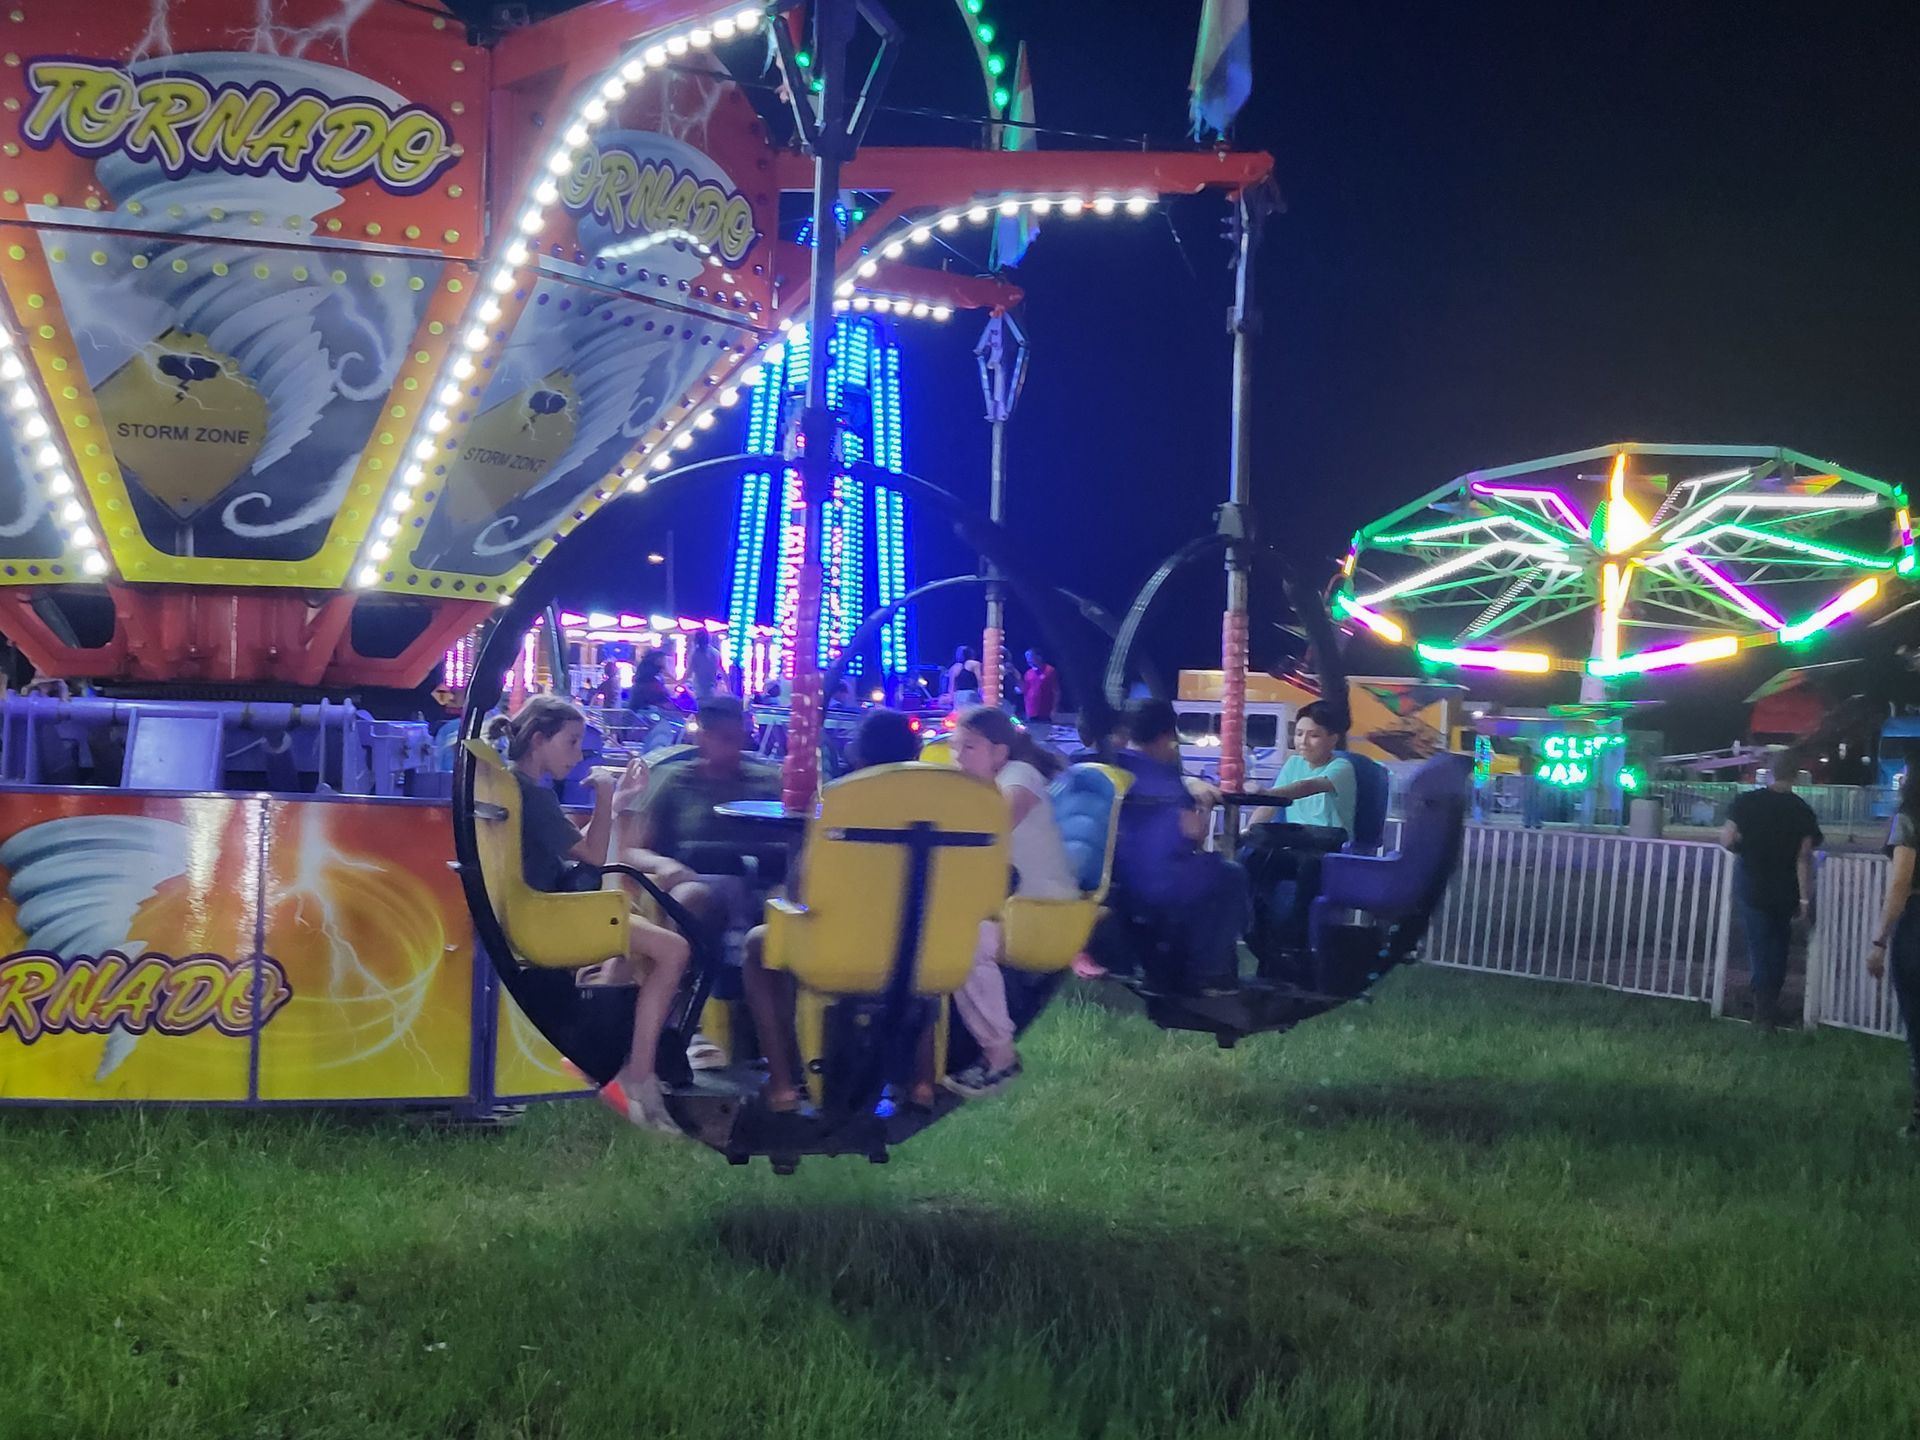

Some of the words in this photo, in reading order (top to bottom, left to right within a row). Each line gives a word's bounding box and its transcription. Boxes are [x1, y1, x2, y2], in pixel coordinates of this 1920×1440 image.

[24, 60, 454, 190] TORNADO
[556, 146, 757, 263] ORNADO
[116, 422, 190, 441] STORM
[195, 427, 250, 445] ZONE
[464, 447, 510, 466] STORM
